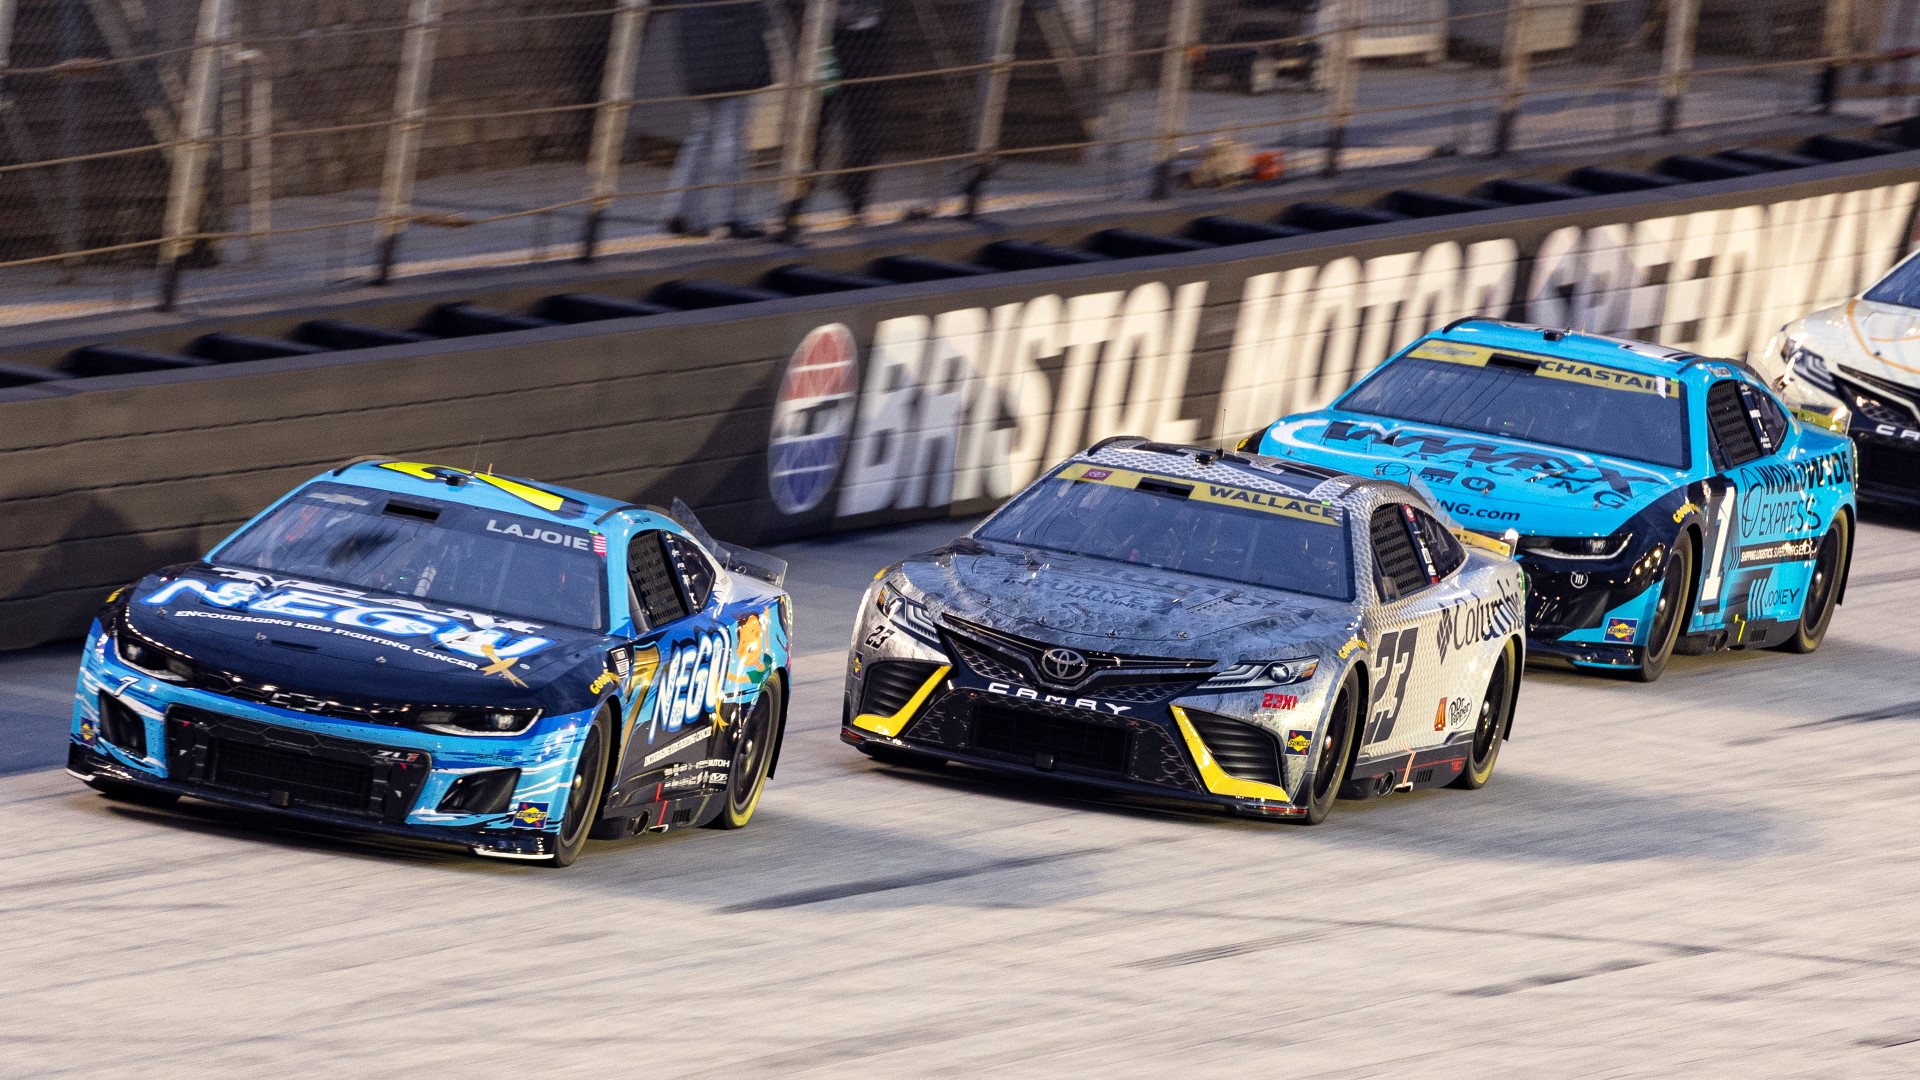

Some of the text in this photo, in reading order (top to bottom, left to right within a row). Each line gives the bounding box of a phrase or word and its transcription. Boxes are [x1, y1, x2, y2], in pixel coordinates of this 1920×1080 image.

[835, 280, 1210, 517] BRISTOL
[1754, 450, 1851, 496] WORLDWIDE
[1209, 485, 1336, 519] WALLACE
[1437, 499, 1521, 522] NG.com
[1758, 497, 1822, 536] EXPRESS
[486, 518, 590, 552] LAJOIE
[1702, 486, 1736, 602] 1
[175, 610, 479, 671] ENCOURAGING KIDS FIGHTING CANCER
[864, 625, 895, 651] 23
[1608, 627, 1636, 636] SUNOCO
[113, 675, 141, 698] 7
[988, 682, 1132, 716] CAMRY
[1262, 692, 1298, 711] 23XI
[1362, 626, 1420, 747] 23
[614, 641, 661, 780] 7
[1449, 701, 1471, 727] Pepper
[1456, 696, 1466, 712] Dr
[1287, 737, 1312, 748] SUNOCO
[516, 810, 546, 821] SUNOCO
